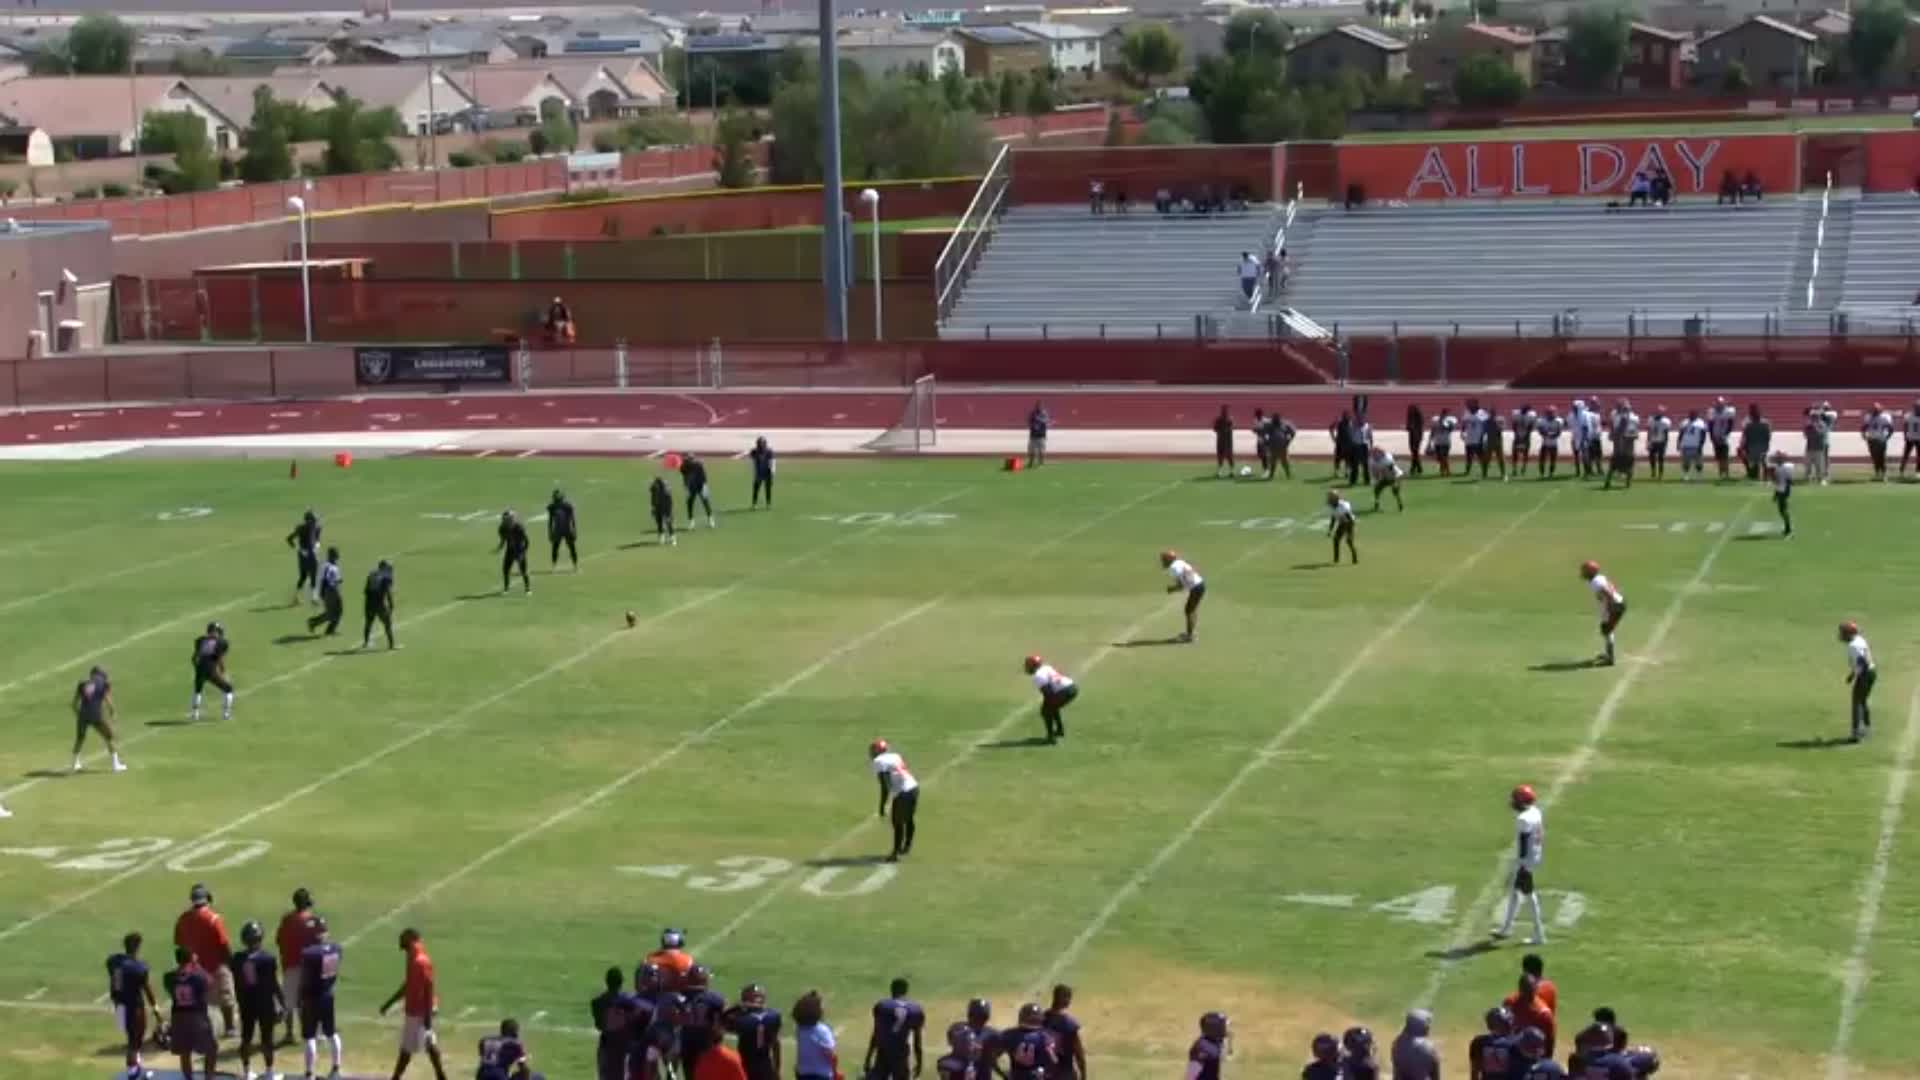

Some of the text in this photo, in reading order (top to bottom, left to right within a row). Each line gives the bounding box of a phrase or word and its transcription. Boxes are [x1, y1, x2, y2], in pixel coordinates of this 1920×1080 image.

[1407, 140, 1721, 197] ALL DAY
[44, 837, 272, 872] 20
[685, 855, 898, 897] 30
